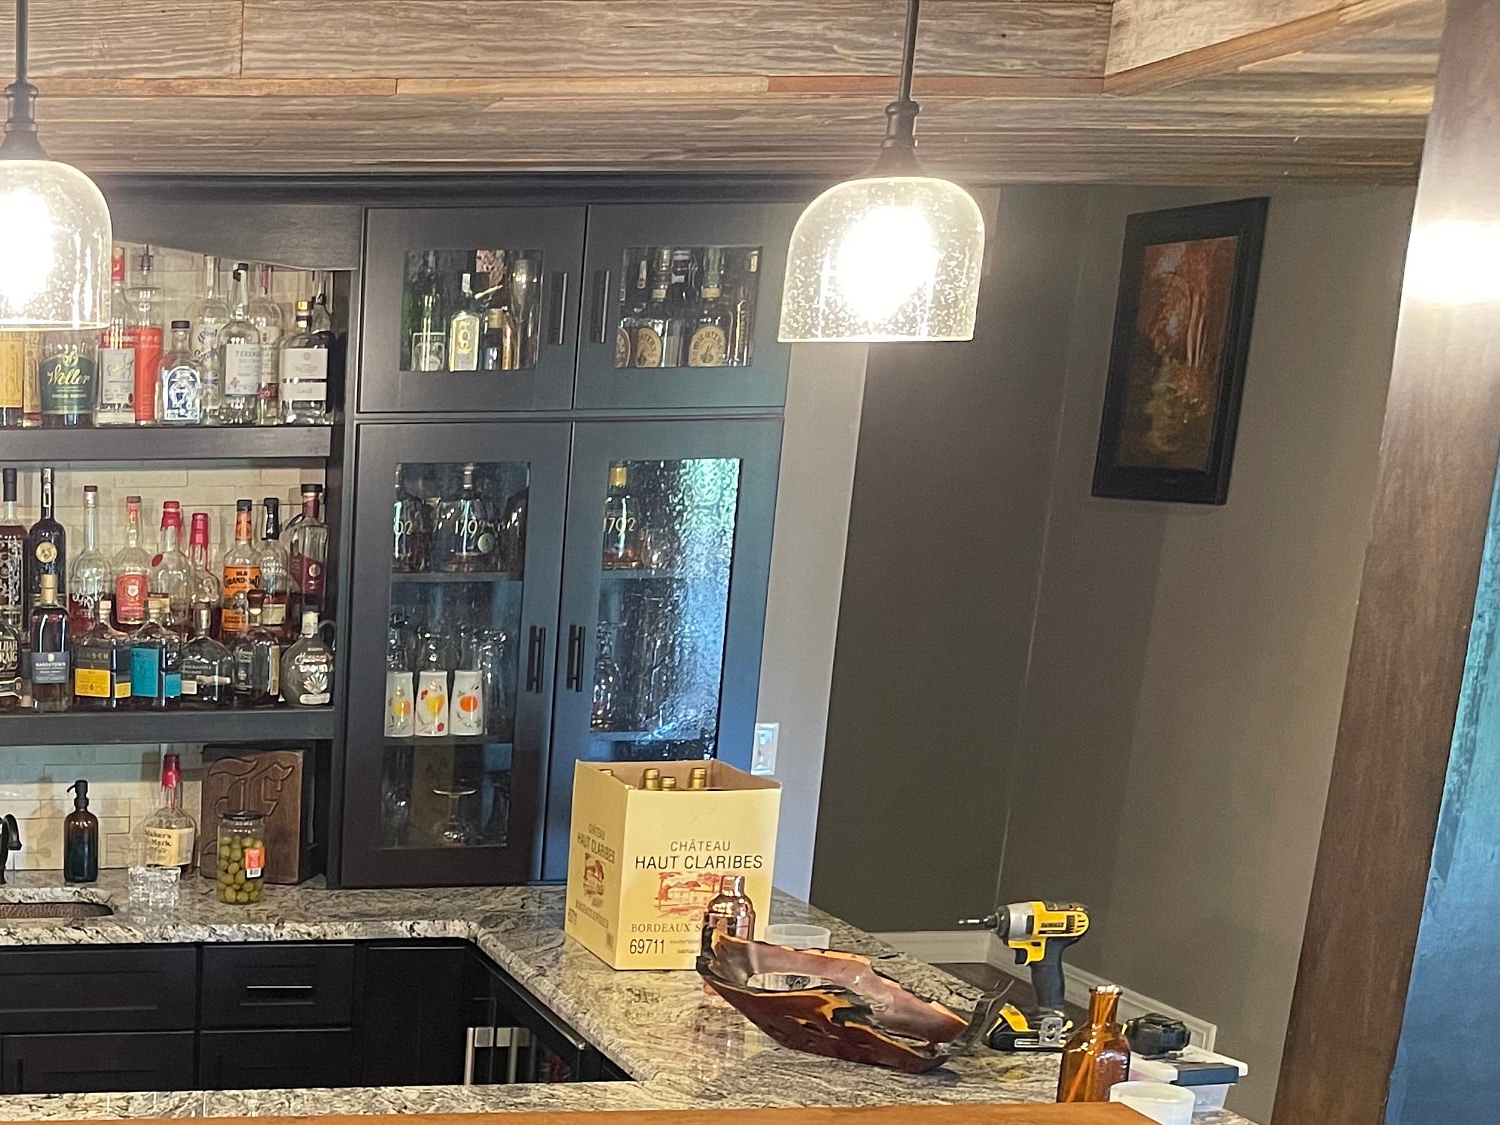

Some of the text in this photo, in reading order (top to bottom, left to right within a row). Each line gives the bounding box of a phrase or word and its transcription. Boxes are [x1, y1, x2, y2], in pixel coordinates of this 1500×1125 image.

[47, 364, 90, 385] Weller
[603, 517, 636, 535] 1792
[670, 839, 731, 852] CHÂTEAU
[634, 855, 763, 869] HAUT CLARIBES
[631, 923, 691, 933] BORDEAUX
[629, 938, 665, 954] 69711
